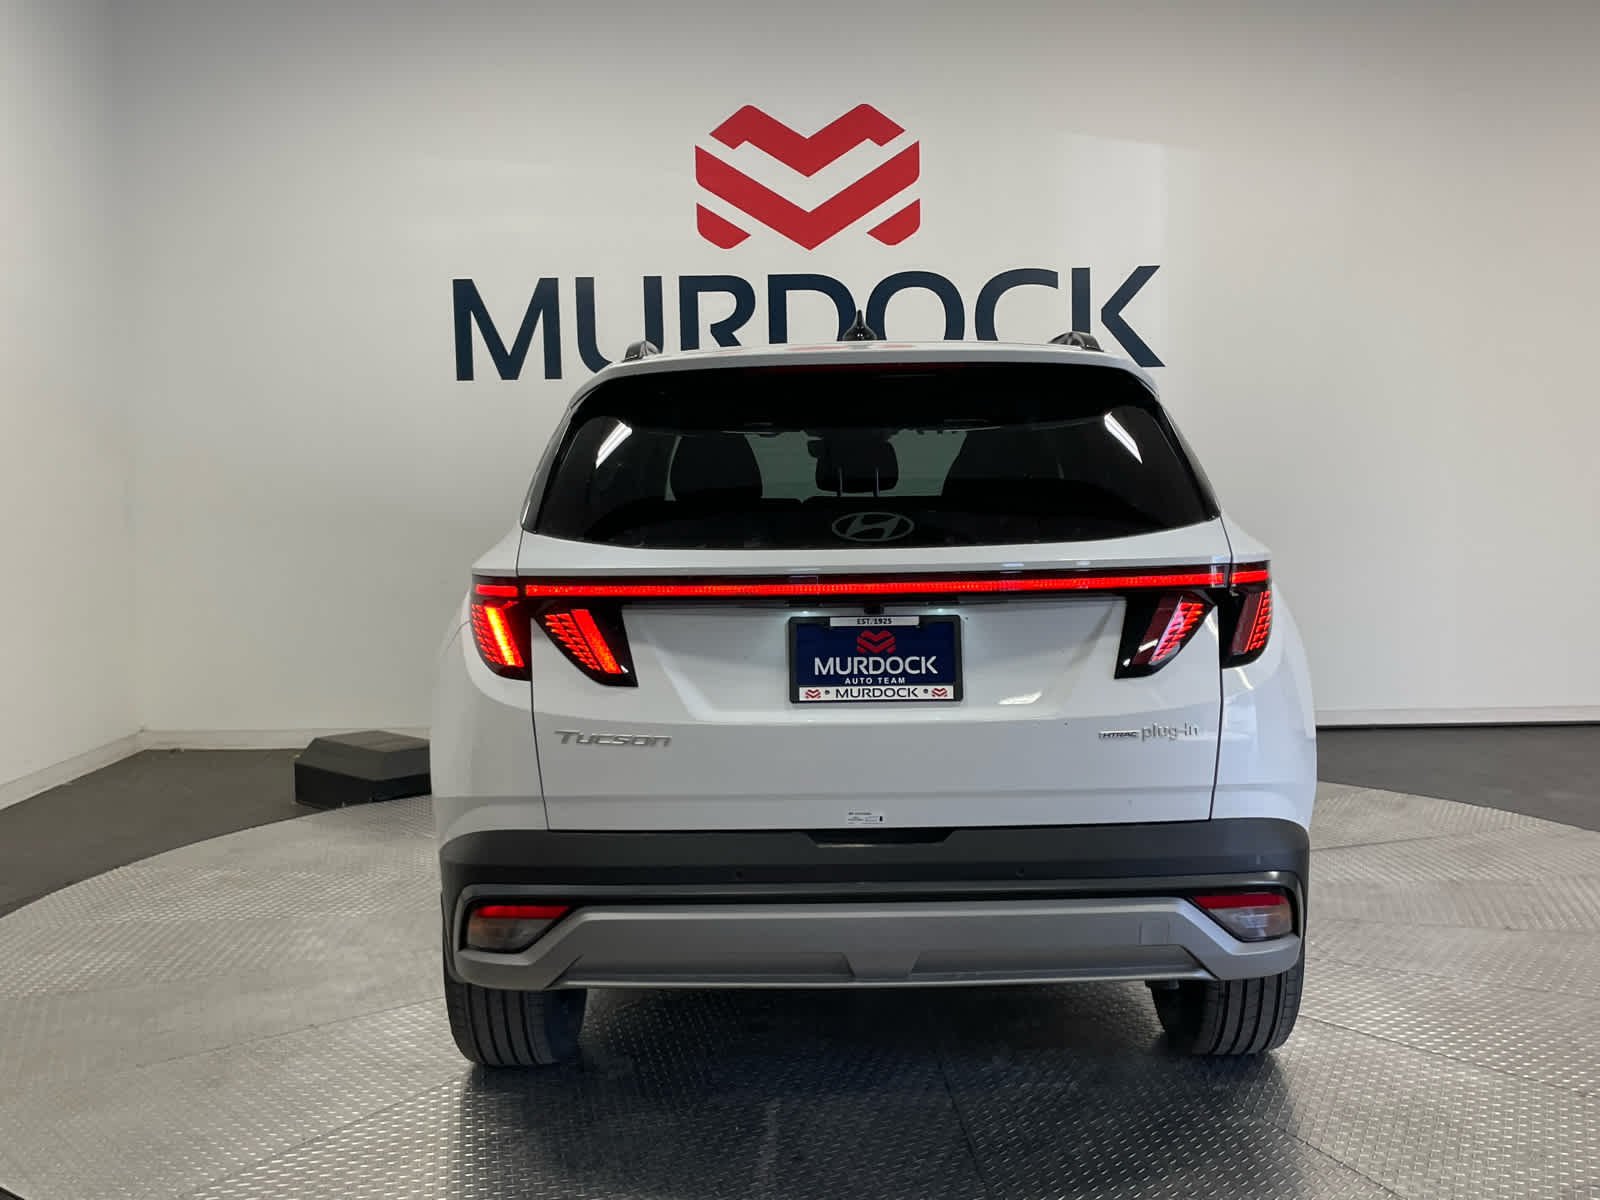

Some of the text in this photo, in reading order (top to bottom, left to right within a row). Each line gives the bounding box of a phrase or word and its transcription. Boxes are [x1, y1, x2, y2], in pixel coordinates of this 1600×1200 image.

[452, 265, 1165, 381] MURDOCK
[814, 656, 939, 676] MURDOCK
[844, 677, 873, 685] AUTO
[835, 687, 919, 699] MURDOCK
[1142, 720, 1199, 742] plug-in
